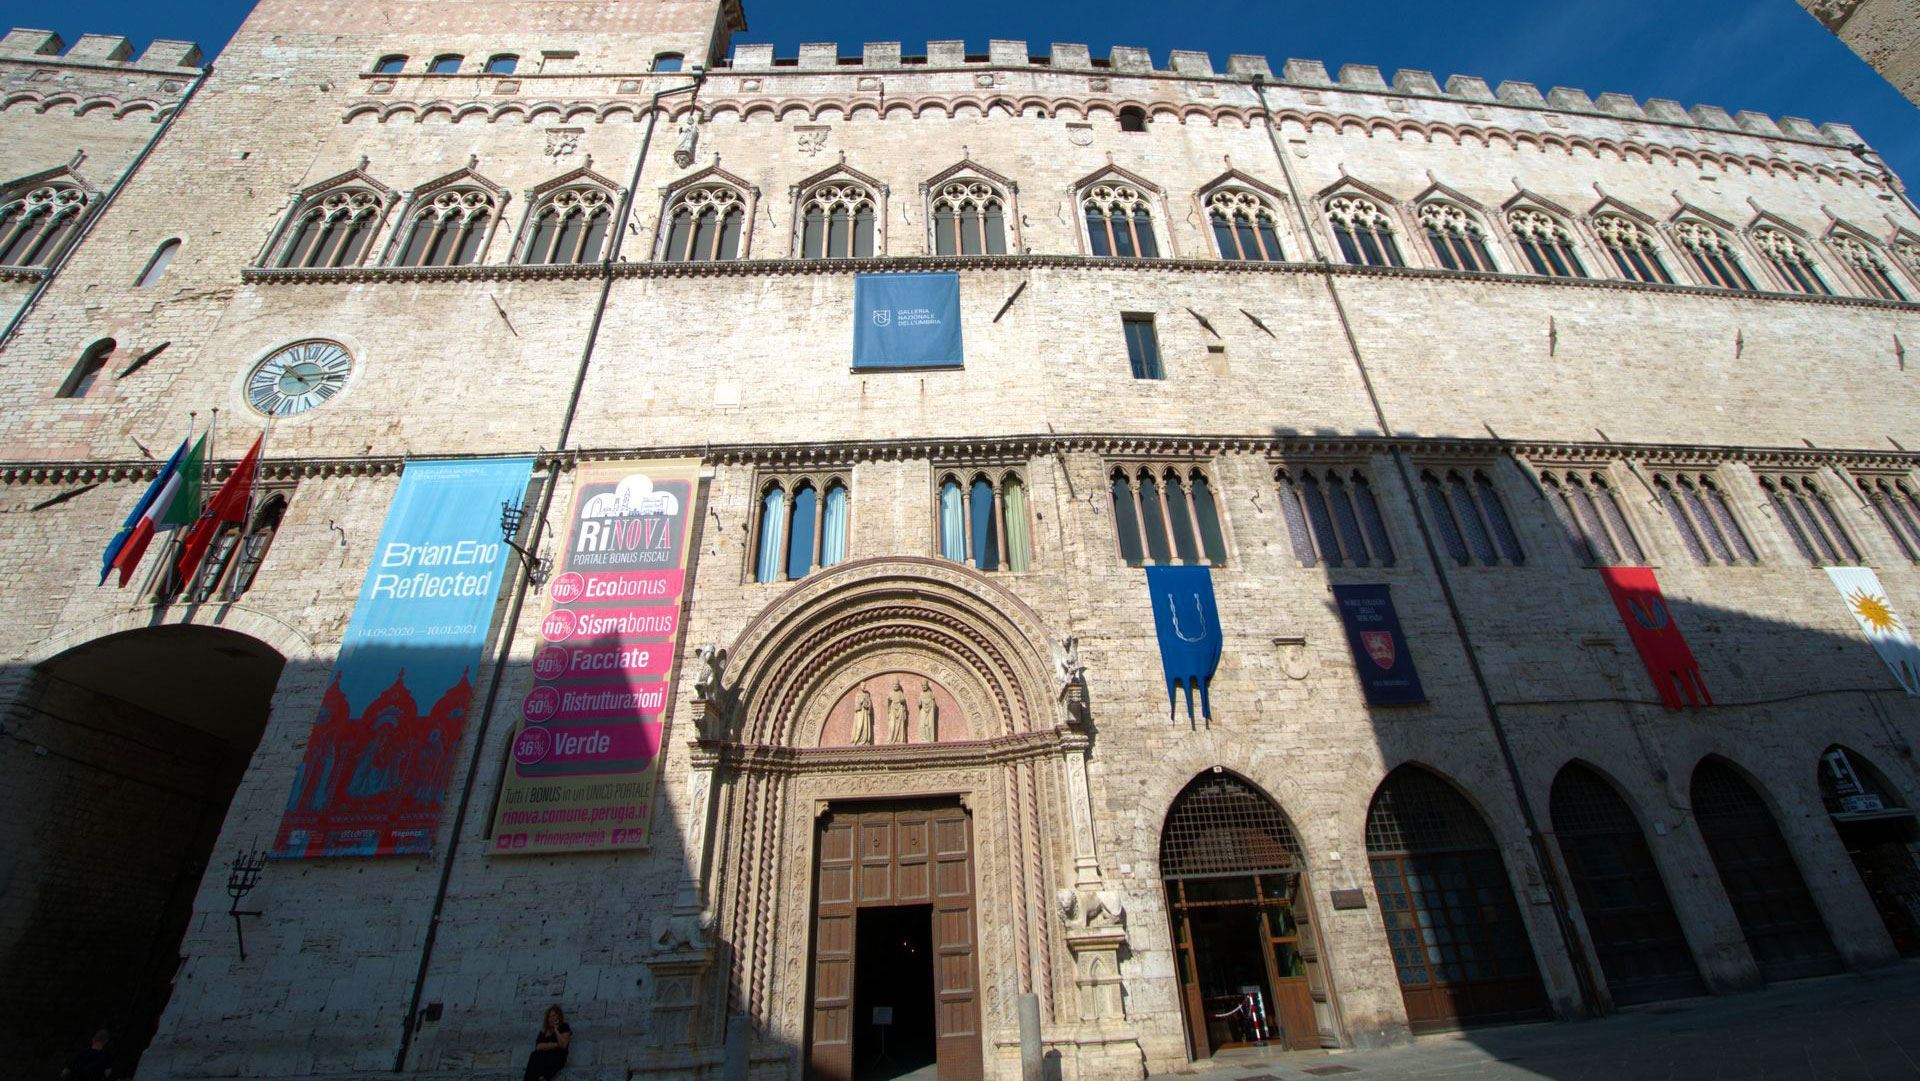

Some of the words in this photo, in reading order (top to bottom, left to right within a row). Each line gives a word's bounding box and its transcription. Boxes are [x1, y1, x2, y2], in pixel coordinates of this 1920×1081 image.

[577, 518, 671, 552] RiNOVA
[381, 541, 452, 567] Brian
[453, 540, 499, 565] Eno
[573, 554, 608, 566] PORTALE
[608, 552, 638, 564] BONUS
[638, 551, 670, 563] FISCALI
[371, 571, 492, 600] Reflected
[553, 583, 579, 596] 110%
[586, 577, 666, 597] Ecobonus
[427, 624, 477, 635] 10.01.2021
[545, 621, 571, 635] 110%
[577, 612, 672, 635] Sismabonus
[536, 659, 562, 673] 90%
[571, 647, 650, 671] Facciate
[526, 700, 553, 714] 50%
[561, 687, 663, 712] Ristrutturazioni
[518, 741, 544, 756] 36%
[555, 731, 610, 756] Verde
[505, 788, 524, 804] Tutti
[529, 786, 562, 803] BONUS
[562, 787, 571, 801] in
[572, 788, 584, 801] un
[586, 783, 613, 801] UNICO
[614, 782, 650, 799] PORTALE
[501, 801, 648, 826] rinova.comune.perugia.it
